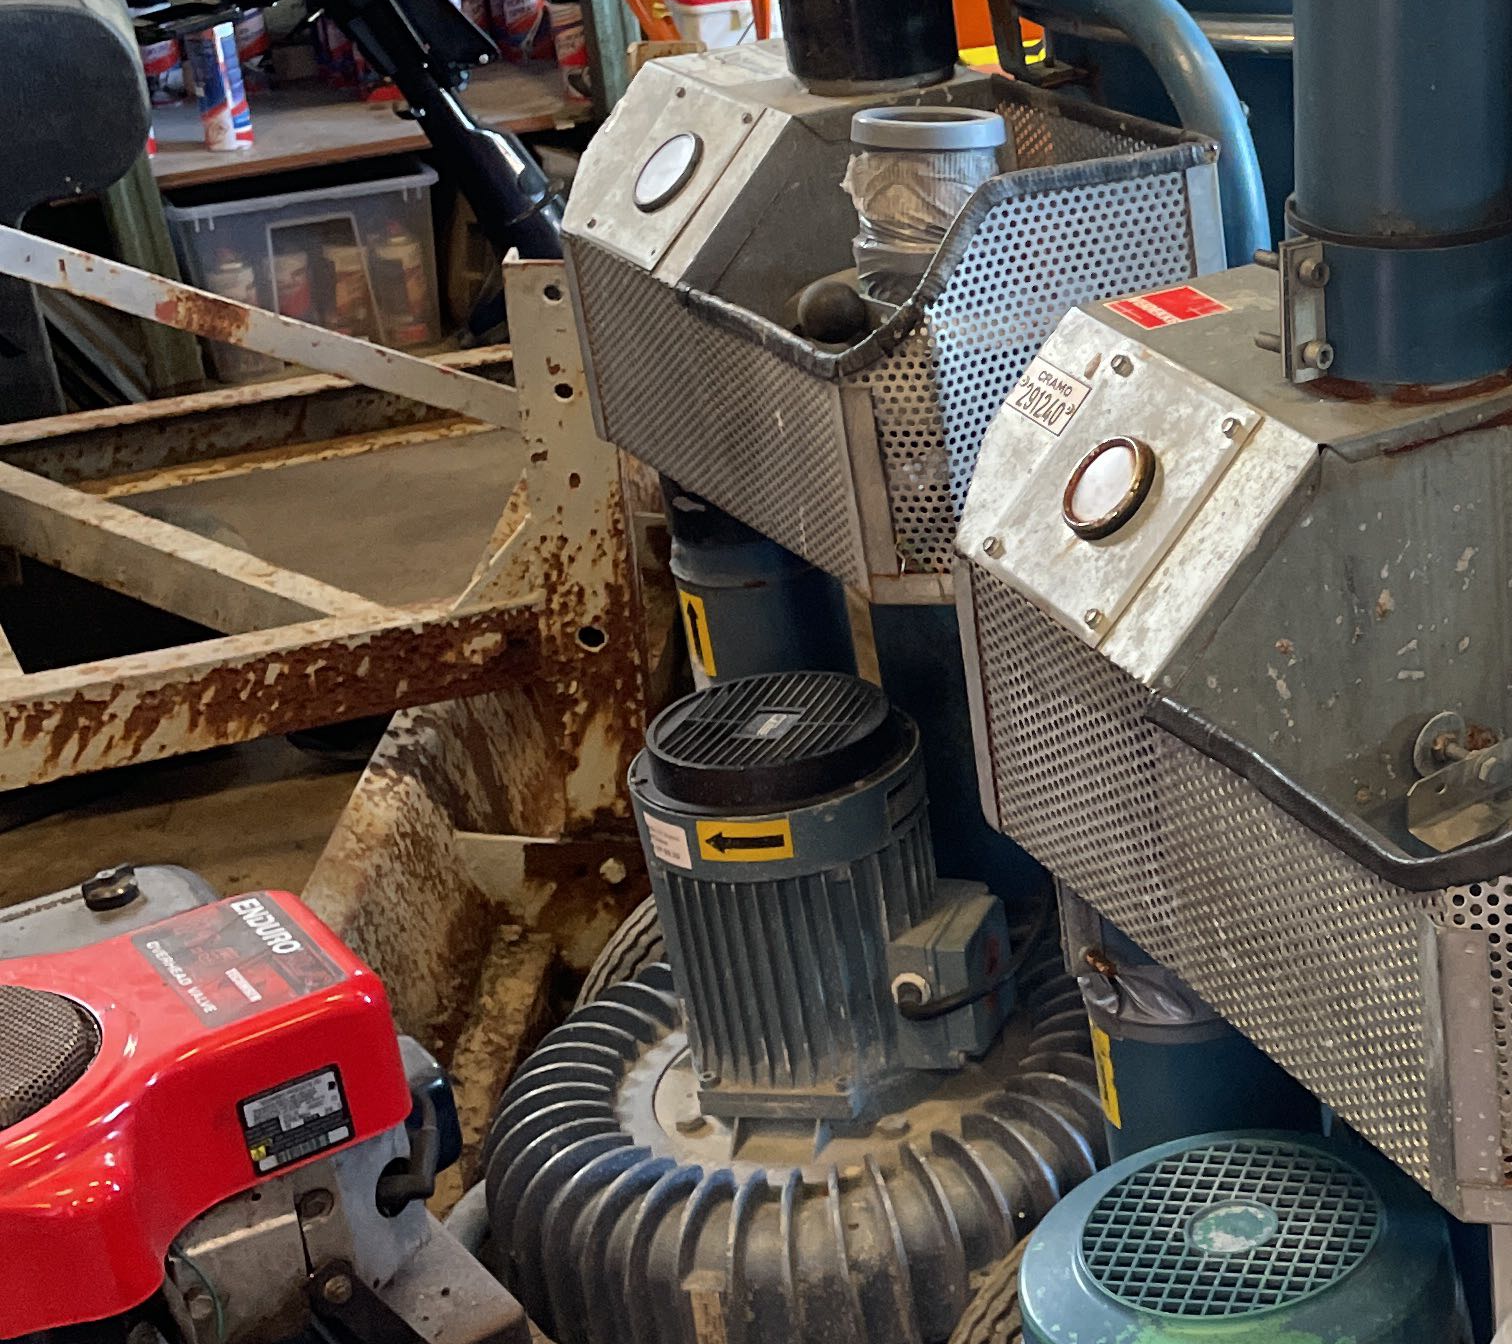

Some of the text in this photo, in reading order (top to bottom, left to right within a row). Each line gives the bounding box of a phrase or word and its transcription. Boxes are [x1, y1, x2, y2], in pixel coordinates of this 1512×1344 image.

[1015, 382, 1067, 426] 291240
[1037, 370, 1073, 397] CRAMO
[230, 897, 302, 954] ENDURO
